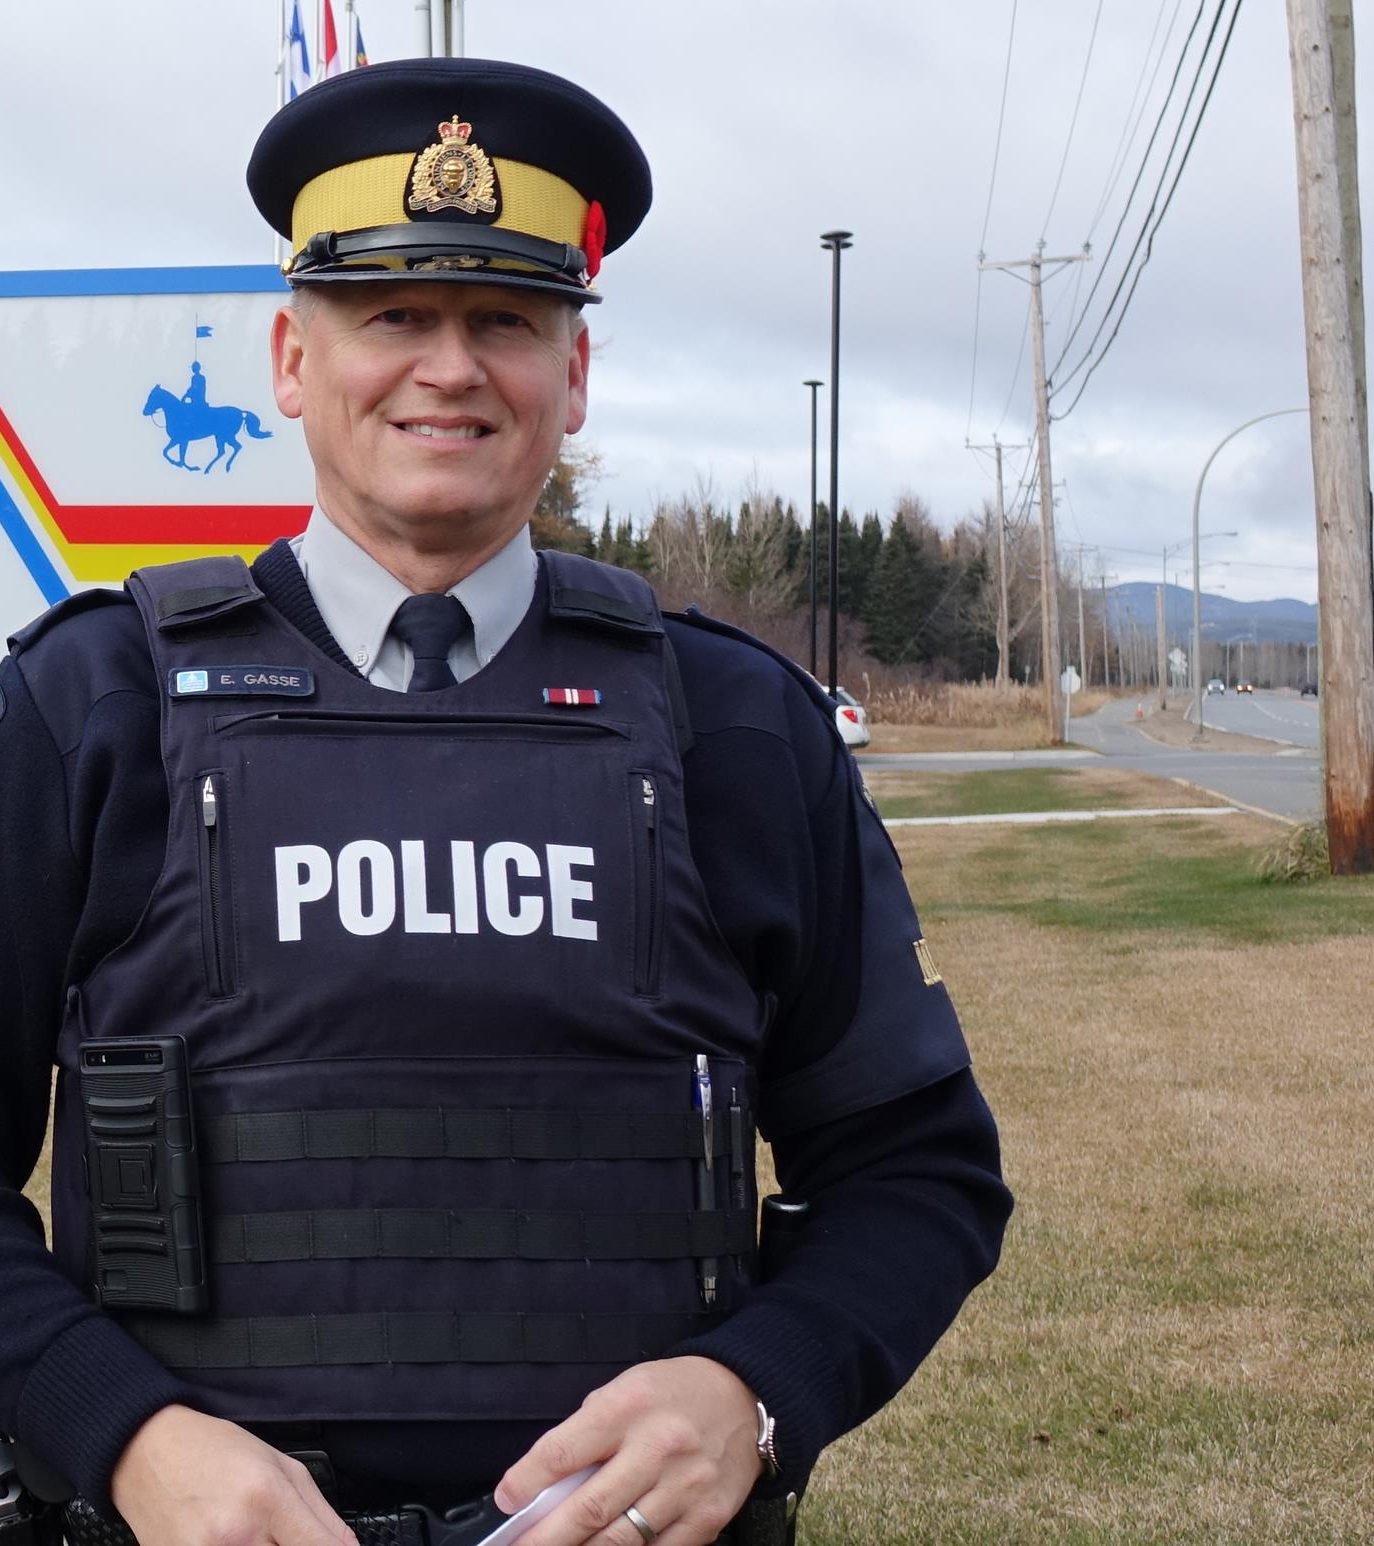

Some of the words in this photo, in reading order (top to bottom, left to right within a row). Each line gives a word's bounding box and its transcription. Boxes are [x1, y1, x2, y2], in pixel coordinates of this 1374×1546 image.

[220, 674, 235, 685] E.
[243, 673, 300, 687] GASSE
[274, 839, 598, 942] POLICE
